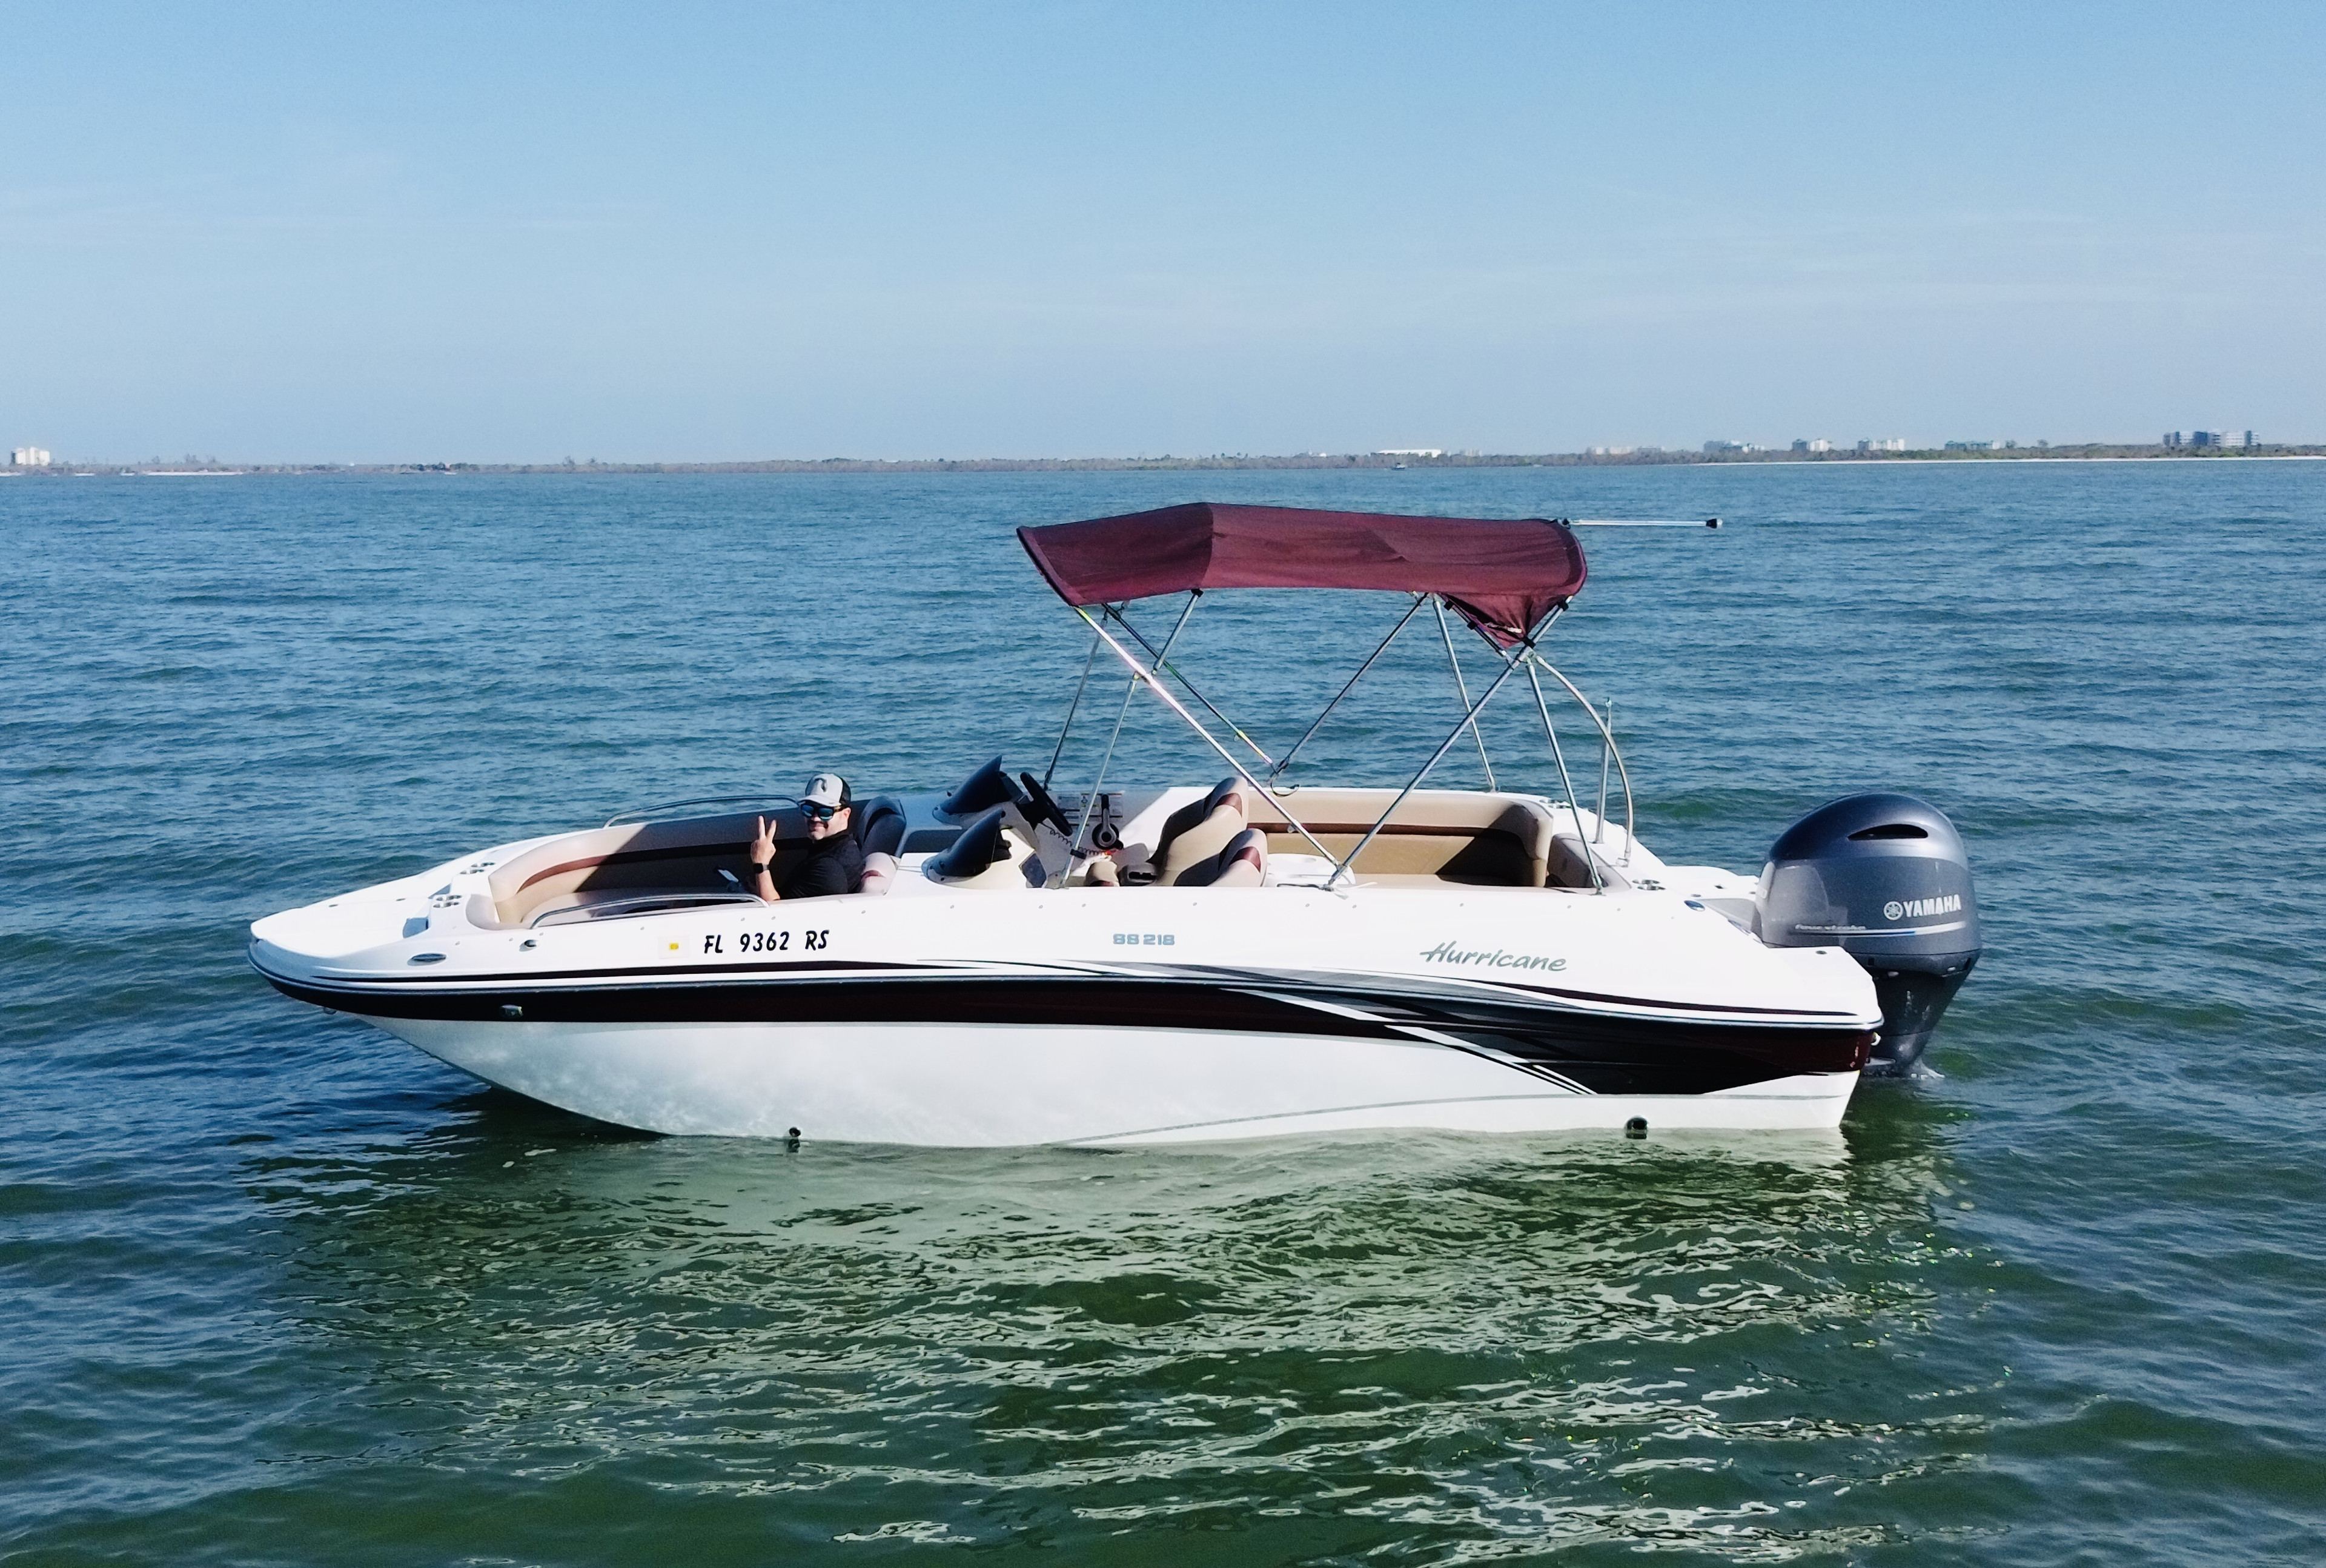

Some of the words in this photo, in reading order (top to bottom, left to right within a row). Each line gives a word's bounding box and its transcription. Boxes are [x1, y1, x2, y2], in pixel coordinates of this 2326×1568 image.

[1903, 894, 1961, 918] YAMAHA
[704, 935, 723, 954] FL
[740, 931, 790, 953] 9362
[805, 930, 829, 951] RS
[1142, 934, 1175, 945] 218
[1419, 940, 1567, 972] Hurricane
